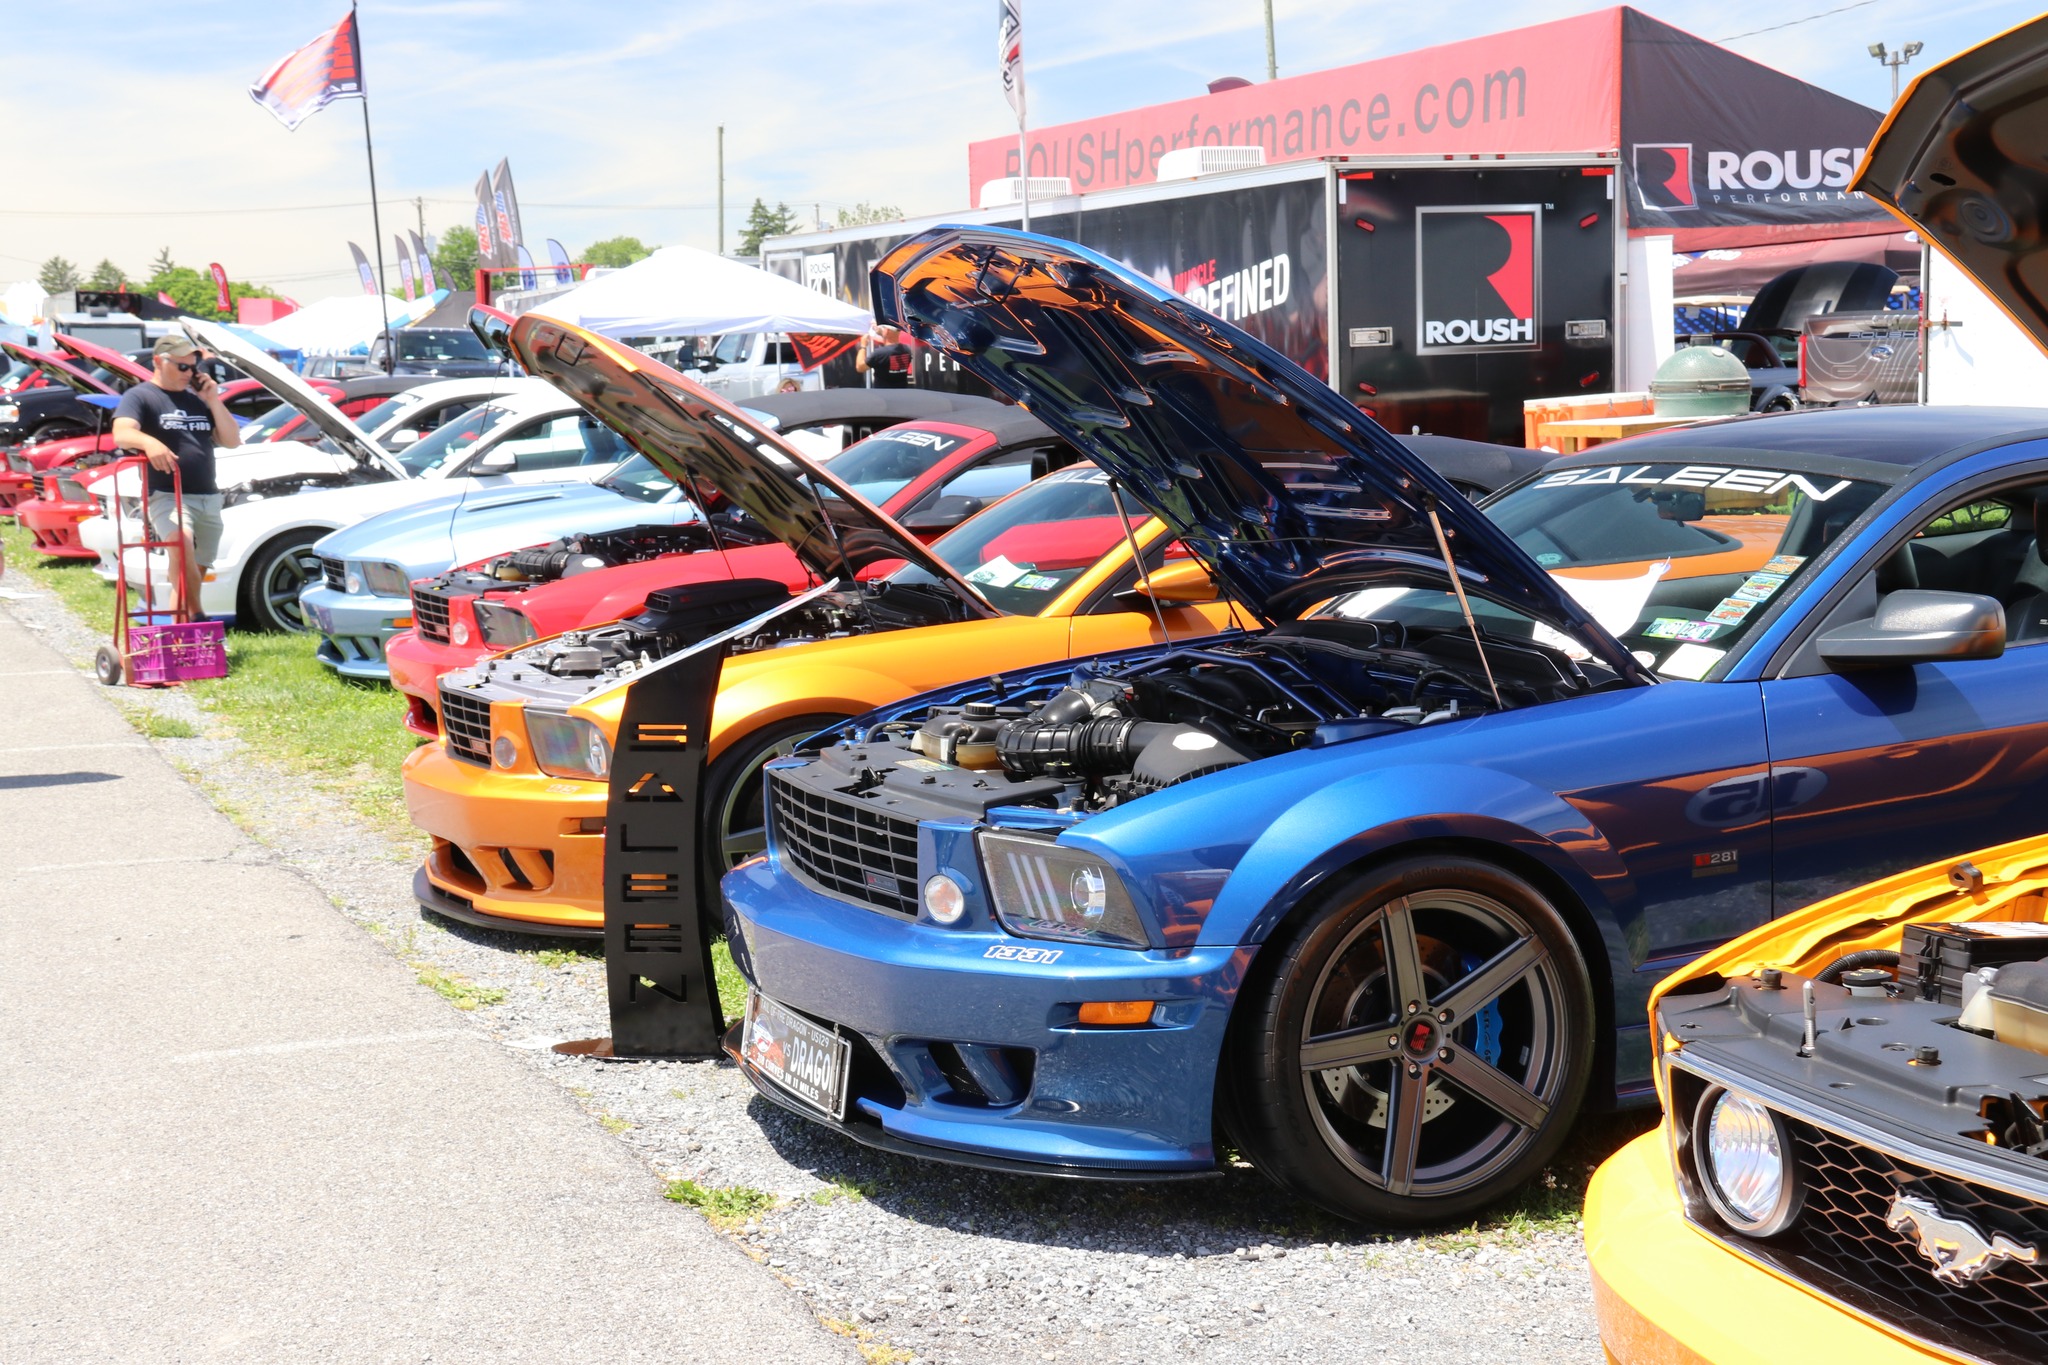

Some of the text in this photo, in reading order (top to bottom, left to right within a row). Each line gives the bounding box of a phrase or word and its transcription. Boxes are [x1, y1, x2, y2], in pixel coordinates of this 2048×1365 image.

[1712, 190, 1864, 204] PERFORMAN
[1173, 258, 1216, 294] MUSCLE
[1425, 318, 1533, 344] ROUSH
[1533, 465, 1852, 501] SALEEN
[620, 723, 688, 1003] SALEEN
[1711, 851, 1737, 864] 281
[983, 945, 1064, 964] 1331
[786, 1013, 808, 1036] DRAGON
[811, 1030, 830, 1048] US129
[782, 1041, 792, 1058] VS
[785, 1071, 792, 1085] IN
[799, 1081, 820, 1101] MILES
